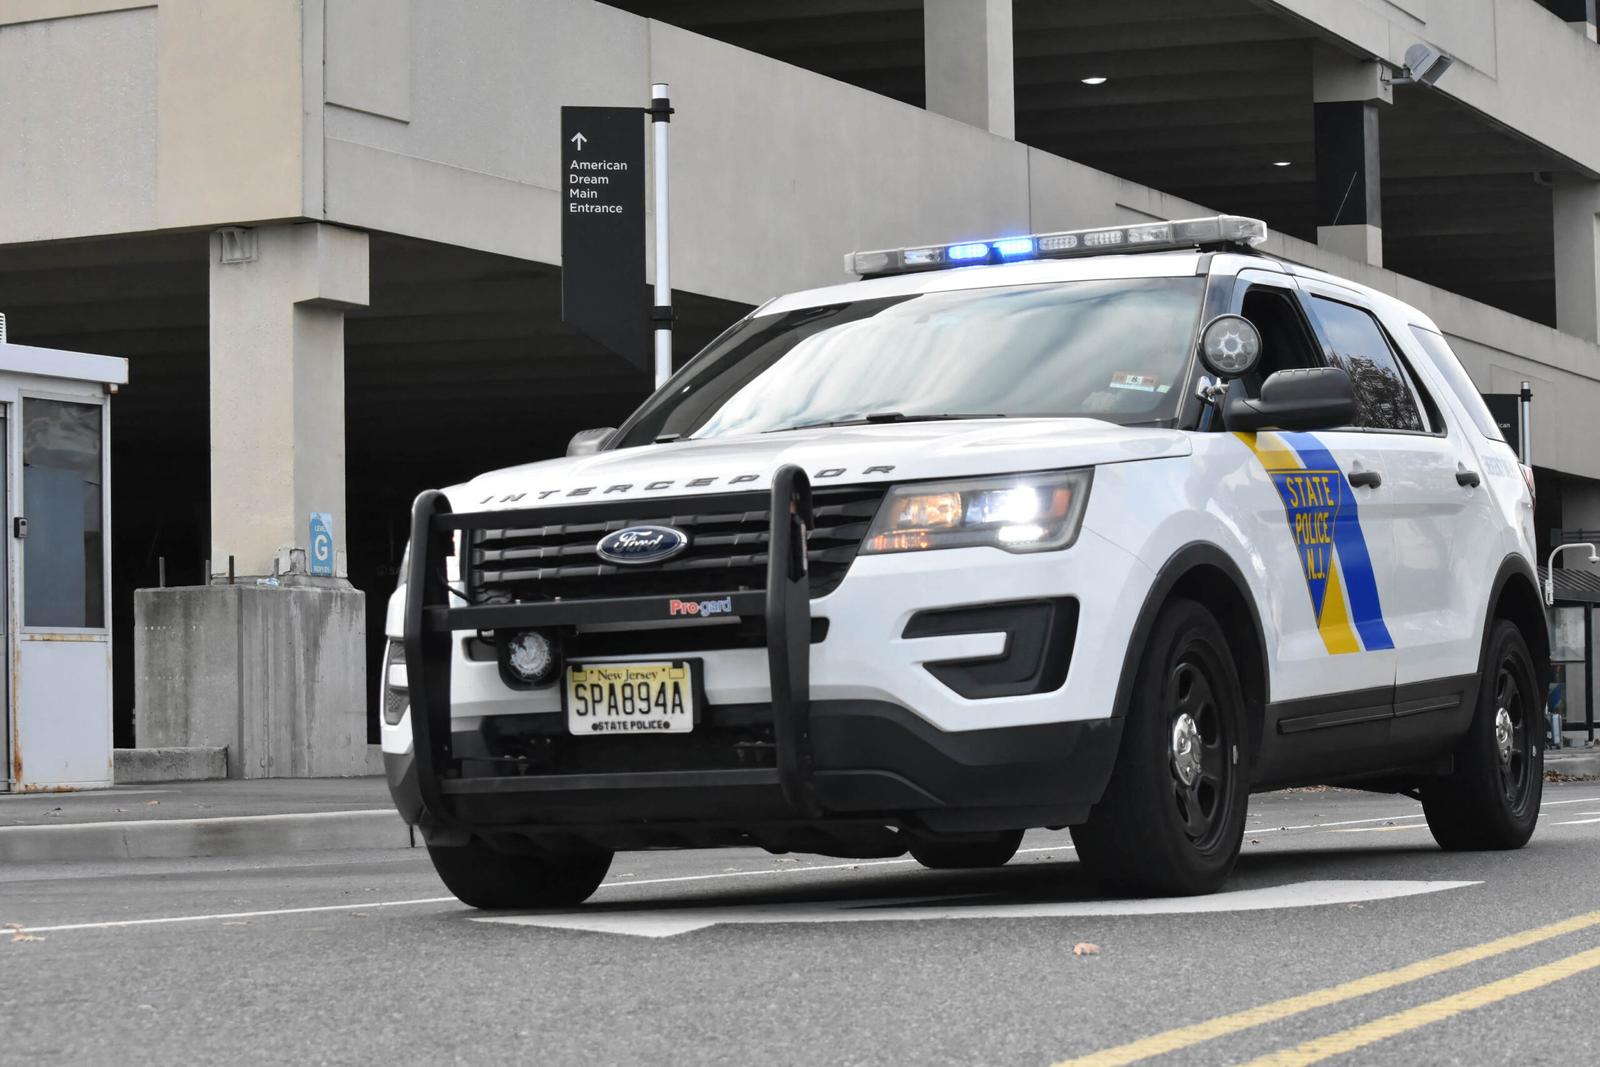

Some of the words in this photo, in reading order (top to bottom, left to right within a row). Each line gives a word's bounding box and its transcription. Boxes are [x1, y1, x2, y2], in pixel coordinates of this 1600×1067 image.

[569, 159, 628, 171] American
[569, 174, 609, 184] Dream
[569, 188, 598, 199] Main
[569, 202, 623, 214] Entrance
[479, 464, 897, 505] INTERCEPOR
[1286, 477, 1335, 508] STATE
[1295, 512, 1331, 545] POLICE
[314, 534, 328, 561] G
[613, 531, 664, 551] Ford
[598, 669, 623, 681] New
[626, 669, 658, 681] Jersey
[574, 681, 685, 716] SPA894A
[598, 721, 629, 731] STATE
[630, 719, 664, 730] POLICE
